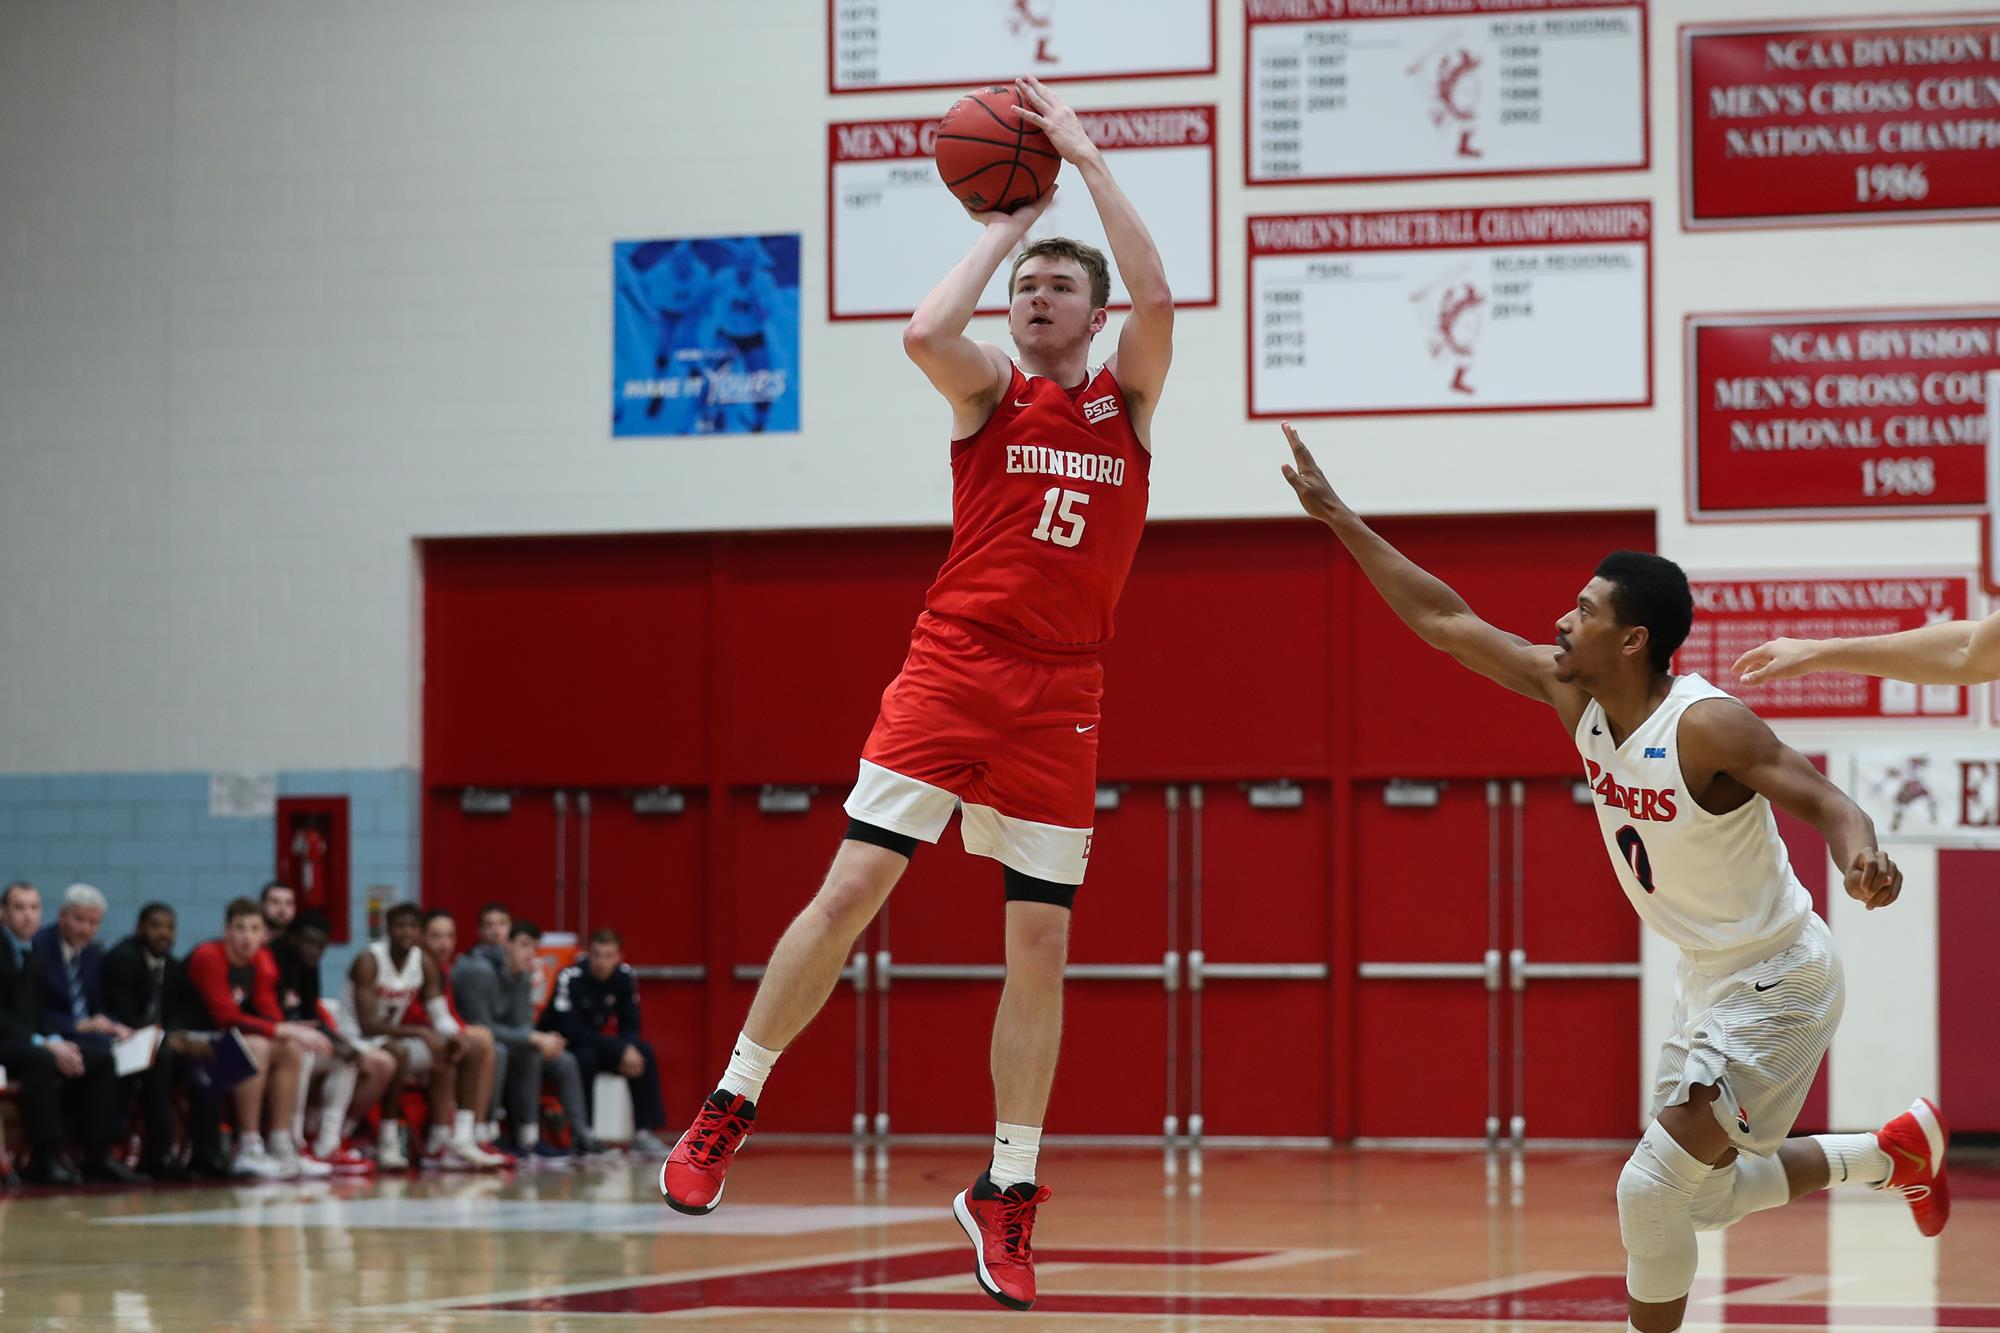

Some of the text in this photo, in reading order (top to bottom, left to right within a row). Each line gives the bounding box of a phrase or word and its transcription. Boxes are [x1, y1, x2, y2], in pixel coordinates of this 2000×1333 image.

[1765, 40, 1848, 70] NCAA
[1852, 34, 1984, 66] DIVISION
[1709, 84, 1805, 119] MEN'S
[1809, 79, 1913, 114] CROSS
[837, 122, 918, 159] MEN'S
[1725, 123, 1876, 159] NATIONAL
[1855, 162, 1929, 202] 1986
[1251, 205, 1648, 250] WOMEN'S BASKETBALL CHAMPIONSHIPS
[1770, 332, 1853, 363] NCAA
[1858, 326, 1990, 360] DIVISION
[1085, 399, 1119, 420] PSAC
[1714, 376, 1811, 411] MEN'S
[1815, 373, 1920, 409] CROSS
[1731, 417, 1880, 451] NATIONAL
[1006, 445, 1126, 487] EDINBORO
[1861, 456, 1936, 497] 1988
[1031, 486, 1091, 548] 15
[1759, 581, 1949, 610] TOURNAMENT
[1956, 760, 2000, 827] E
[1615, 824, 1656, 895] 0
